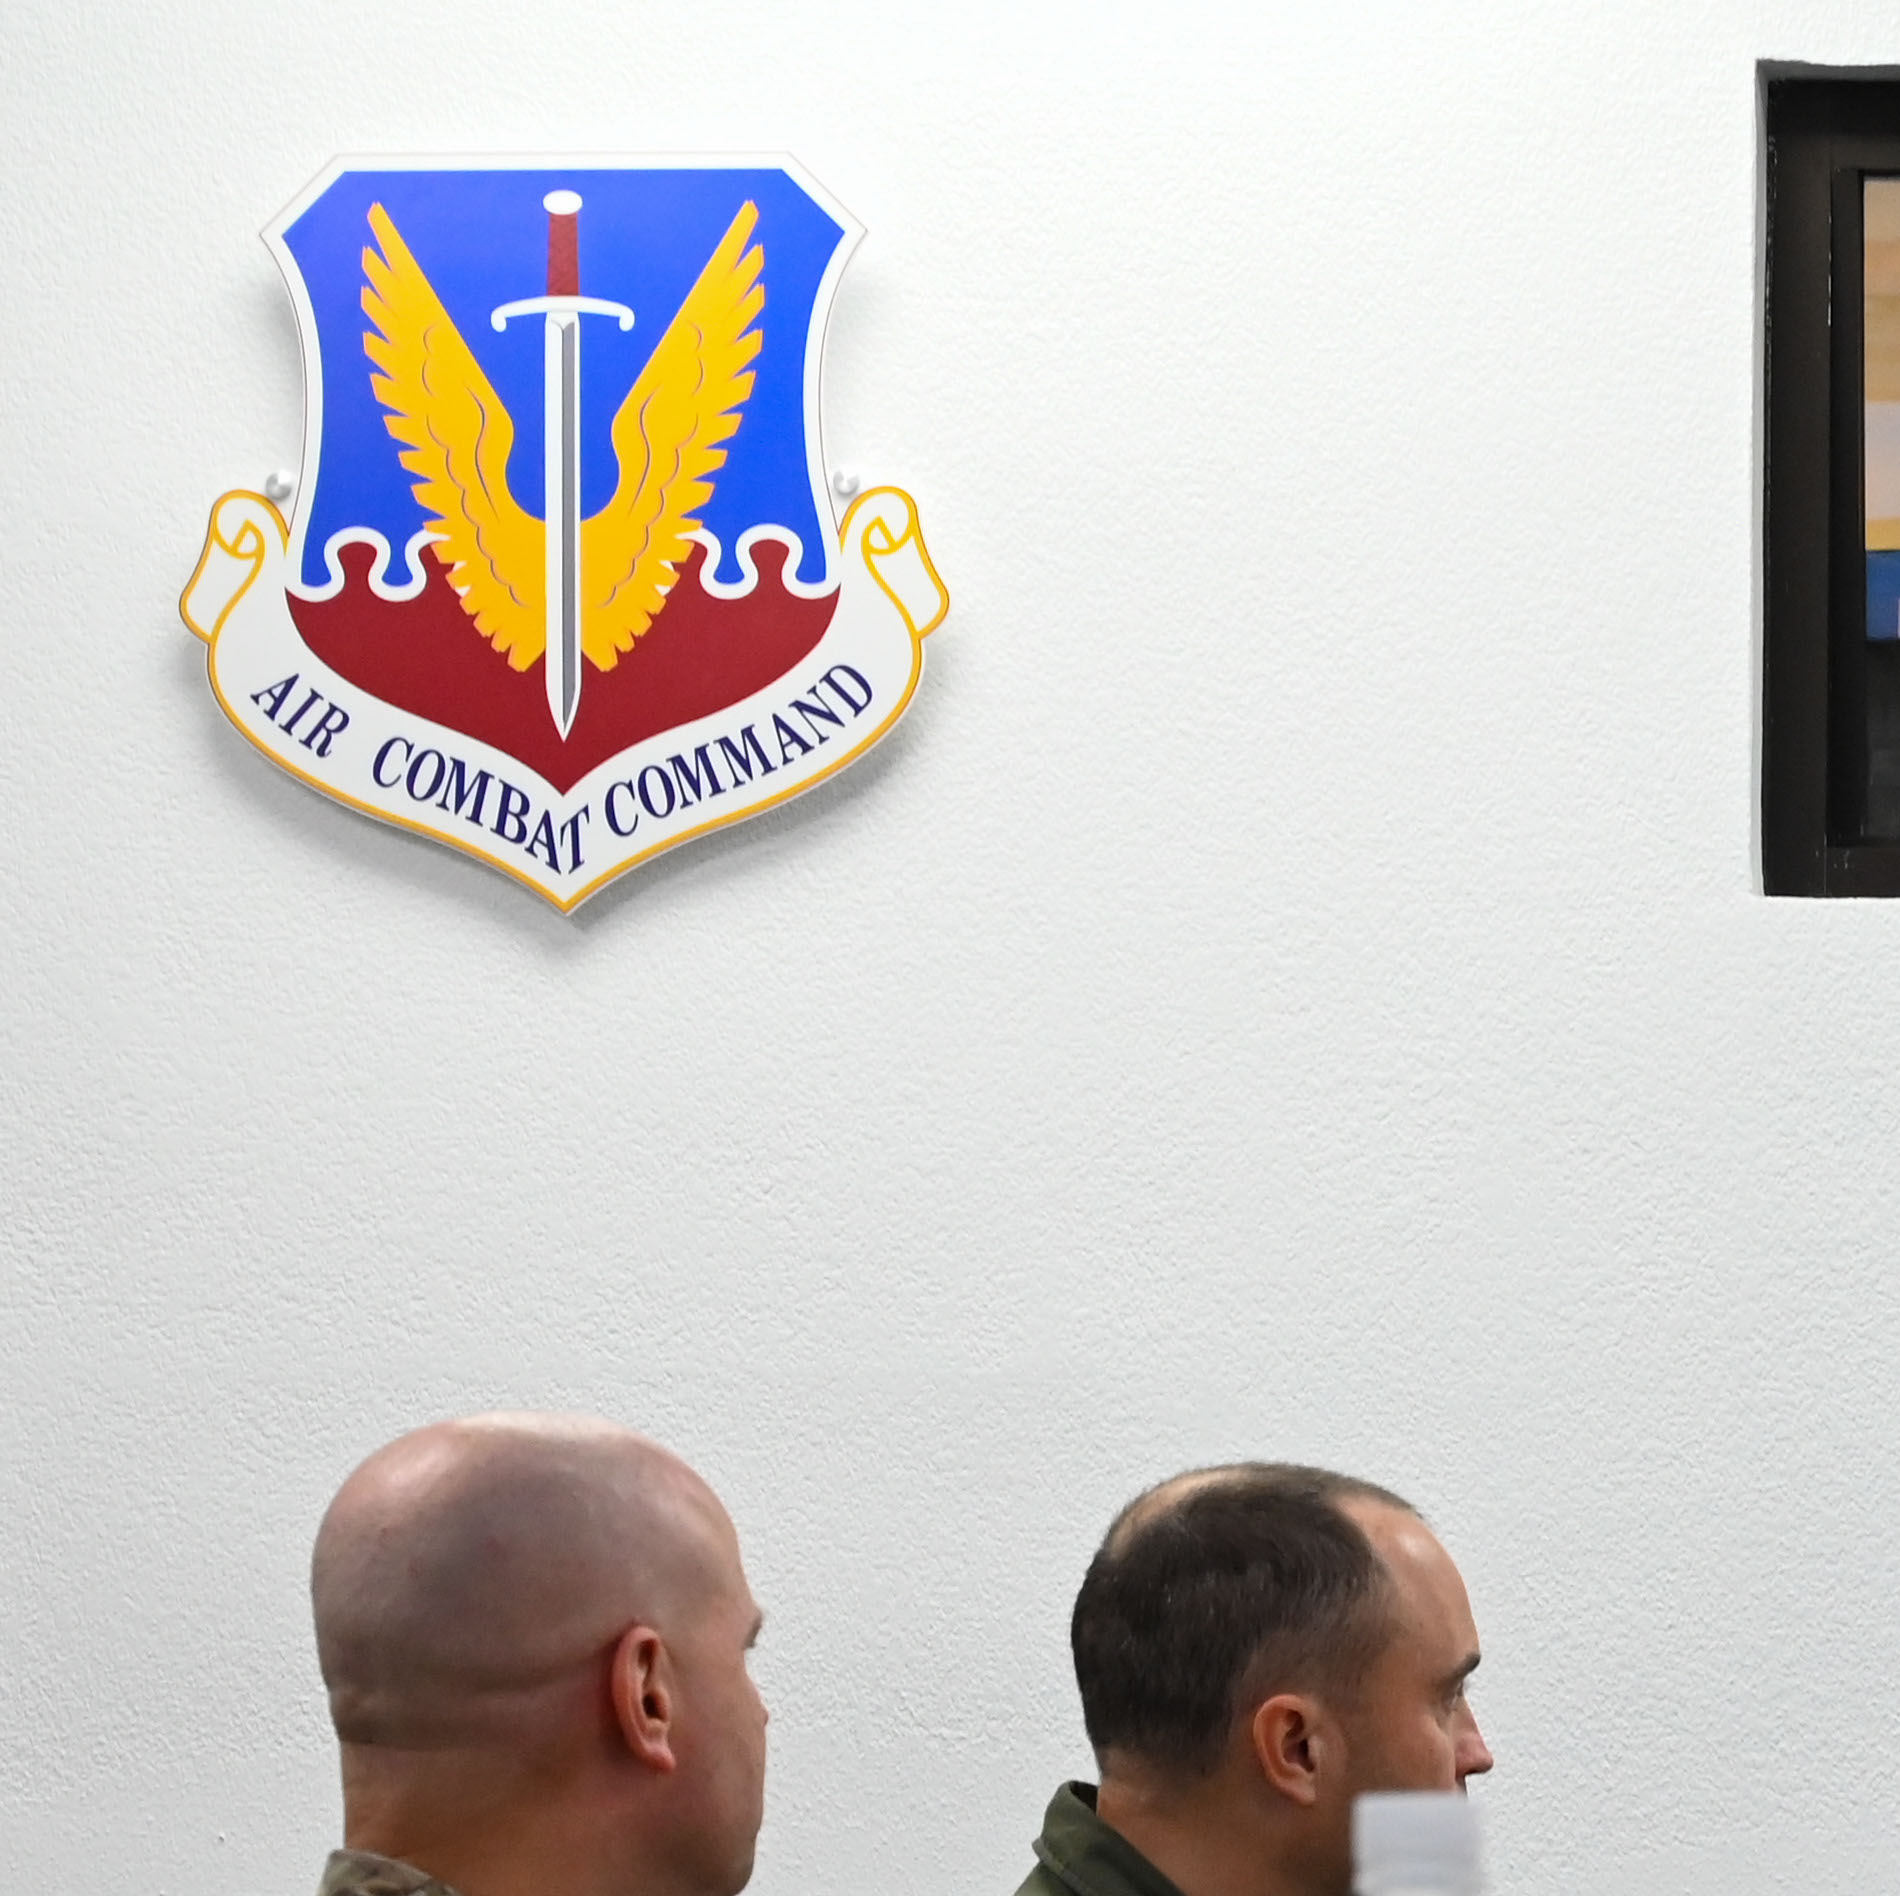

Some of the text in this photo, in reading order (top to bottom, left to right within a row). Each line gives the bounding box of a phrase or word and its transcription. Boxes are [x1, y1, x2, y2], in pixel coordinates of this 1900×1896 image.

[249, 662, 875, 876] AIR COMBAT COMMAND
